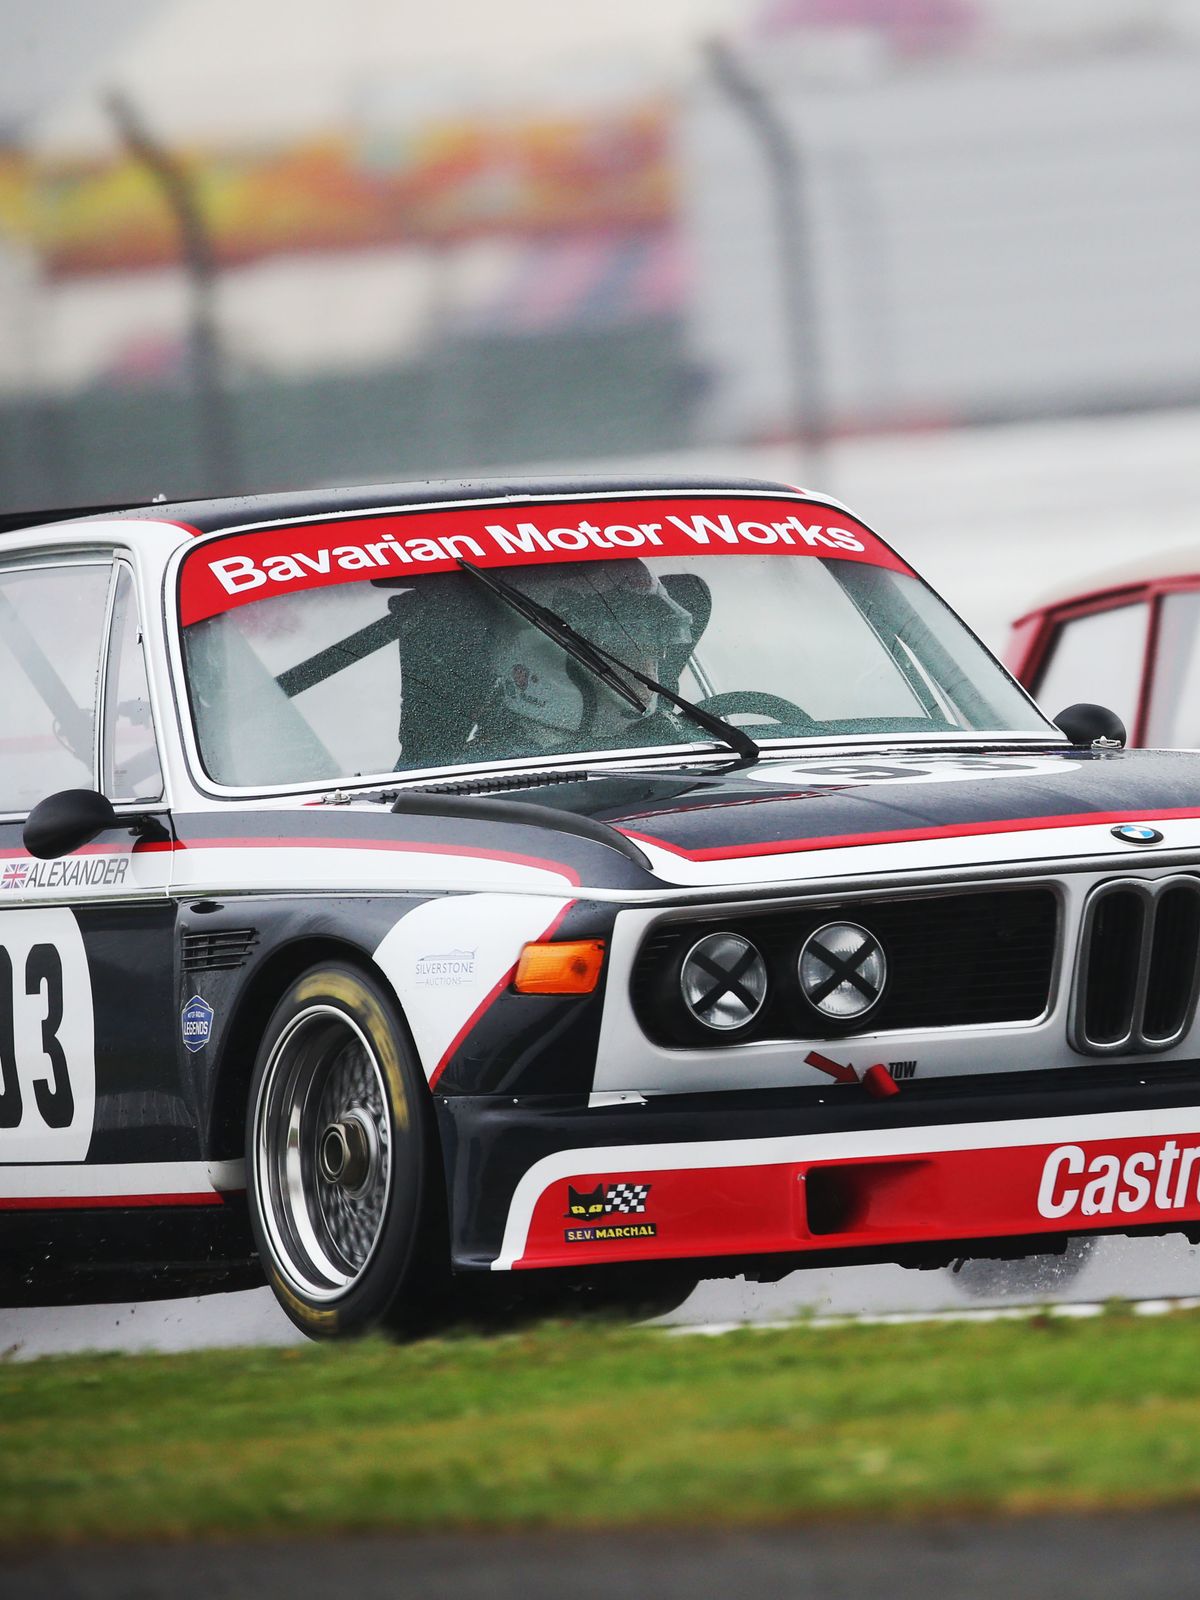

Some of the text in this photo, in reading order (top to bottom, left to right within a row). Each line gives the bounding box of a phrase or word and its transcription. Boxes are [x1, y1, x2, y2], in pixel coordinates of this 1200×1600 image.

[207, 514, 866, 595] Bavarian Motor Works
[25, 858, 130, 888] ALEXANDER
[415, 962, 475, 975] SILVERSTONE
[425, 977, 462, 987] AUCTIONS
[183, 1021, 209, 1036] LEGENDS
[889, 1061, 918, 1079] TOW
[567, 1226, 655, 1241] S.E.V. MARCHAL
